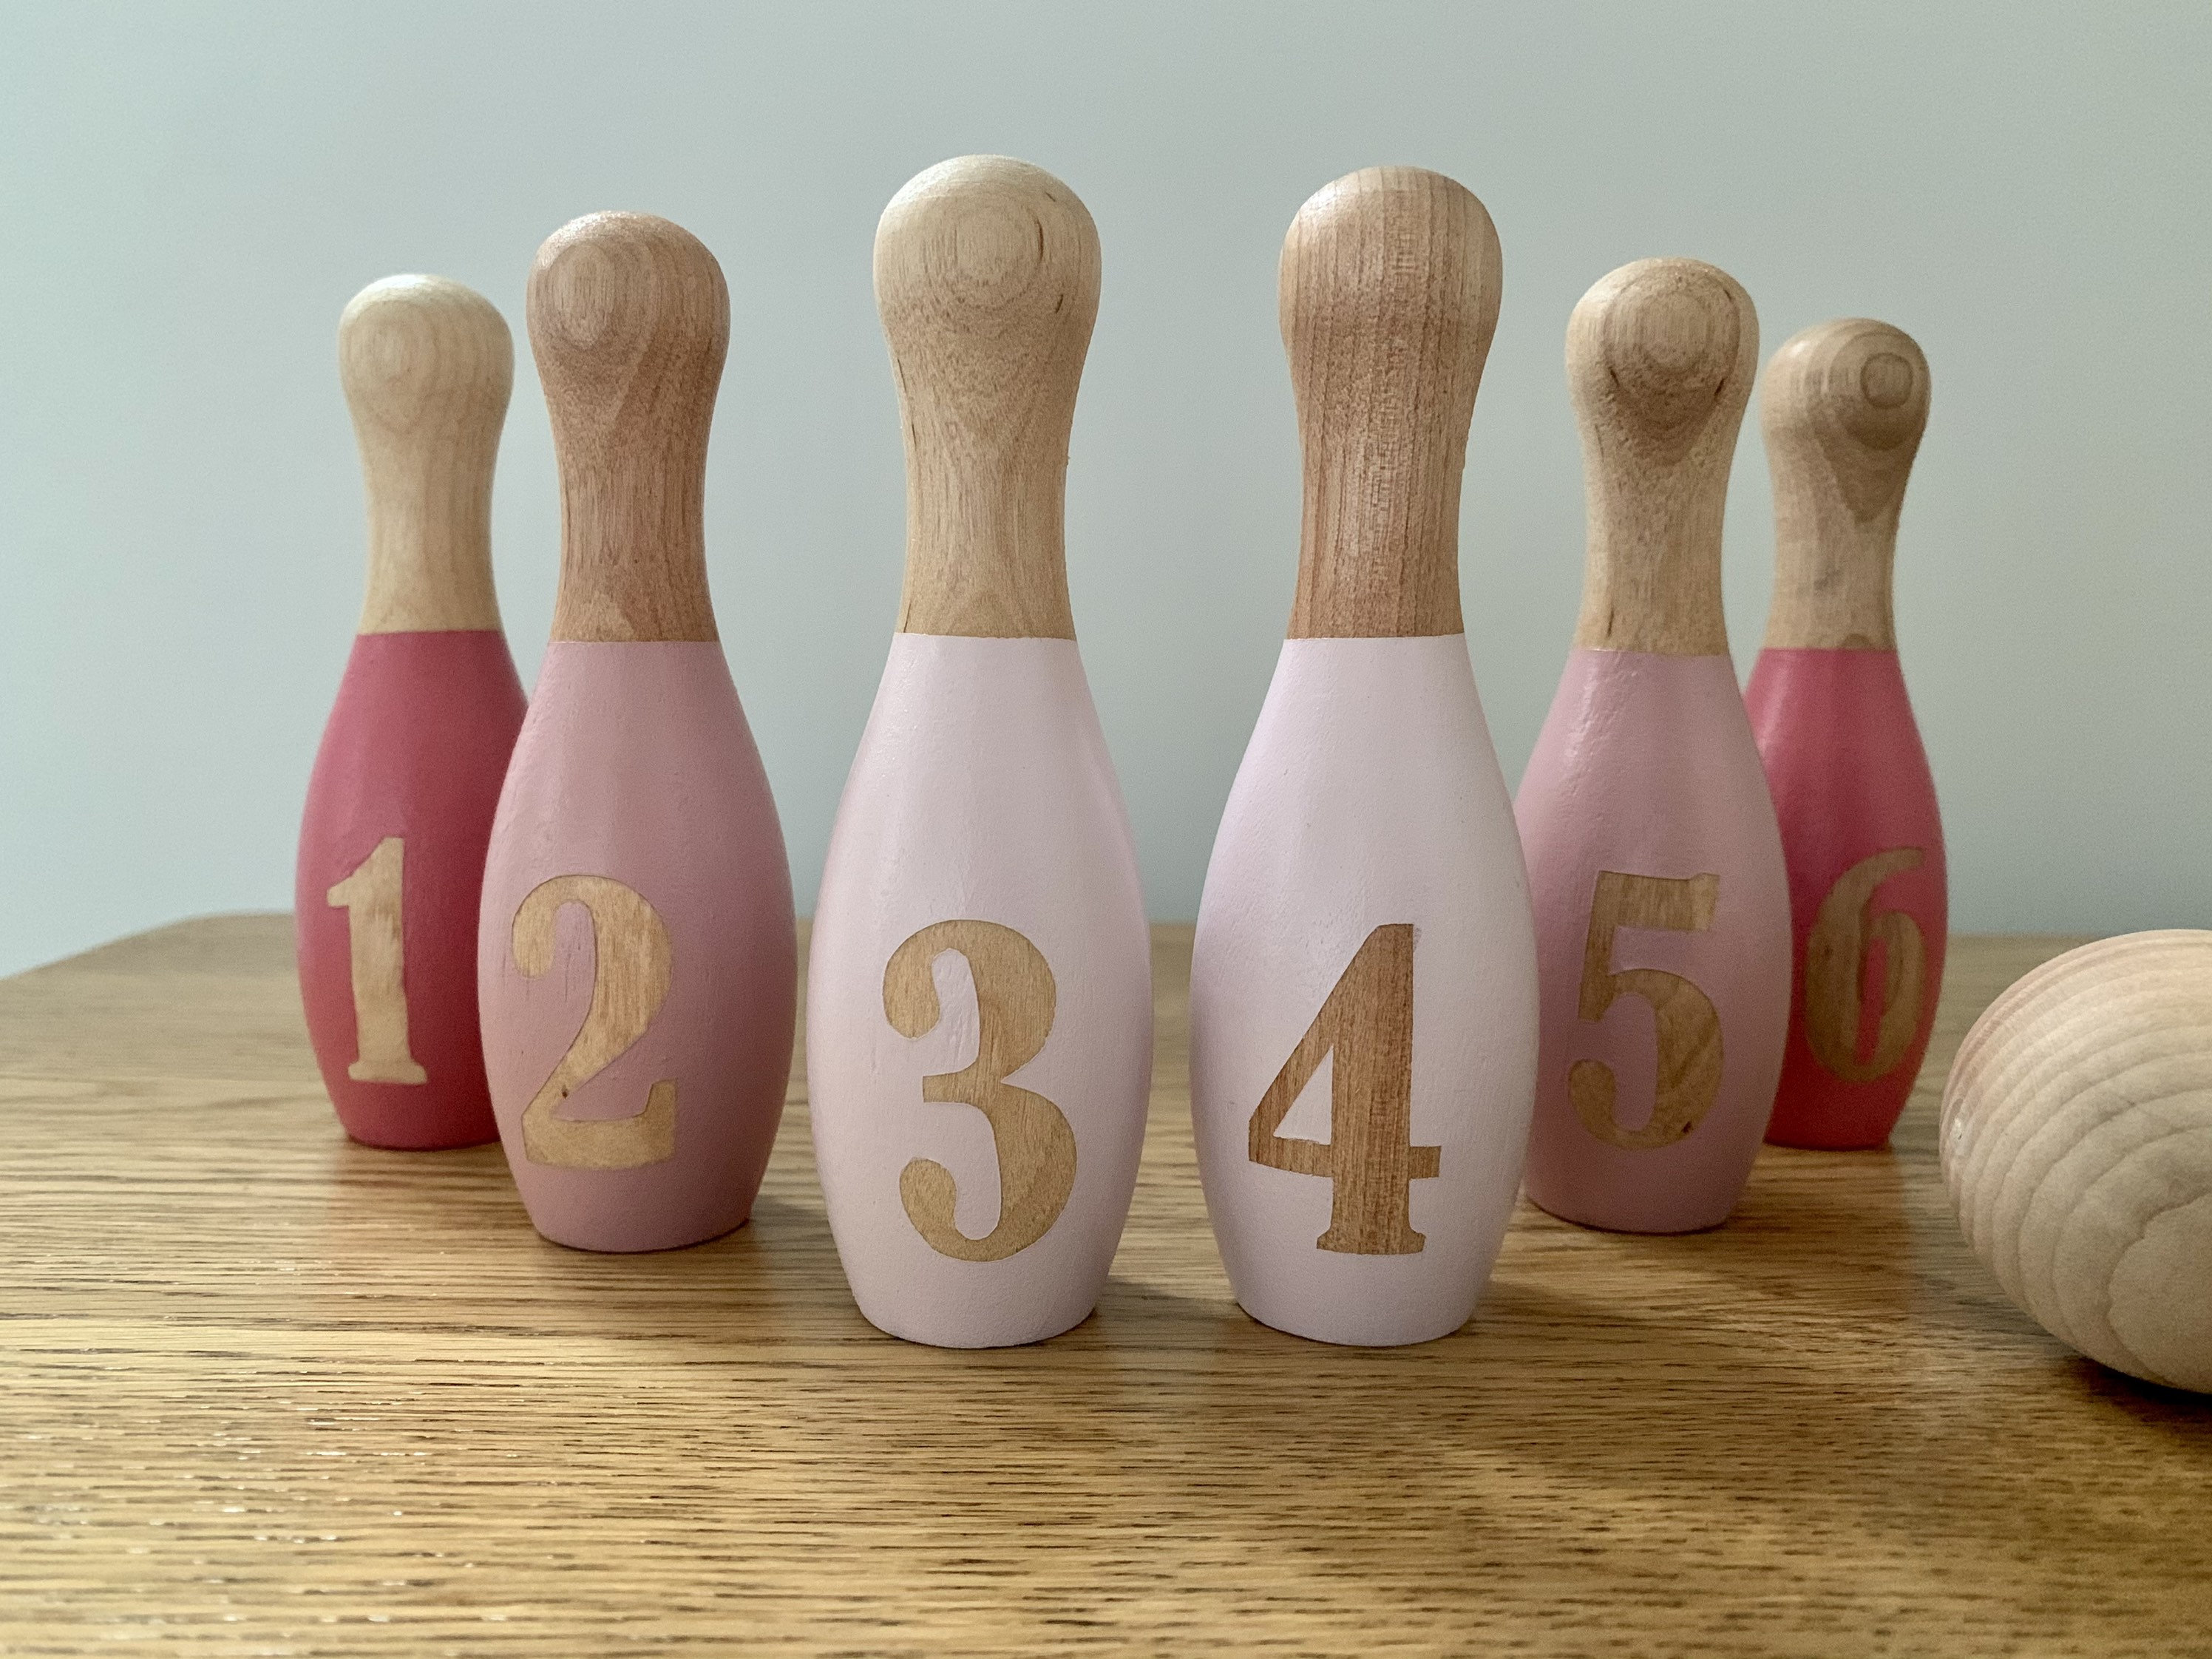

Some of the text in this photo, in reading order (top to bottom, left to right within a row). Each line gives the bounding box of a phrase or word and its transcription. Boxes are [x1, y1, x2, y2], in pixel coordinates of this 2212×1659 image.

[328, 837, 427, 1085] 1
[512, 875, 677, 1169] 2
[883, 920, 1076, 1262] 3
[1248, 923, 1441, 1255] 4
[1569, 870, 1723, 1148] 5
[1805, 847, 1926, 1083] 6
